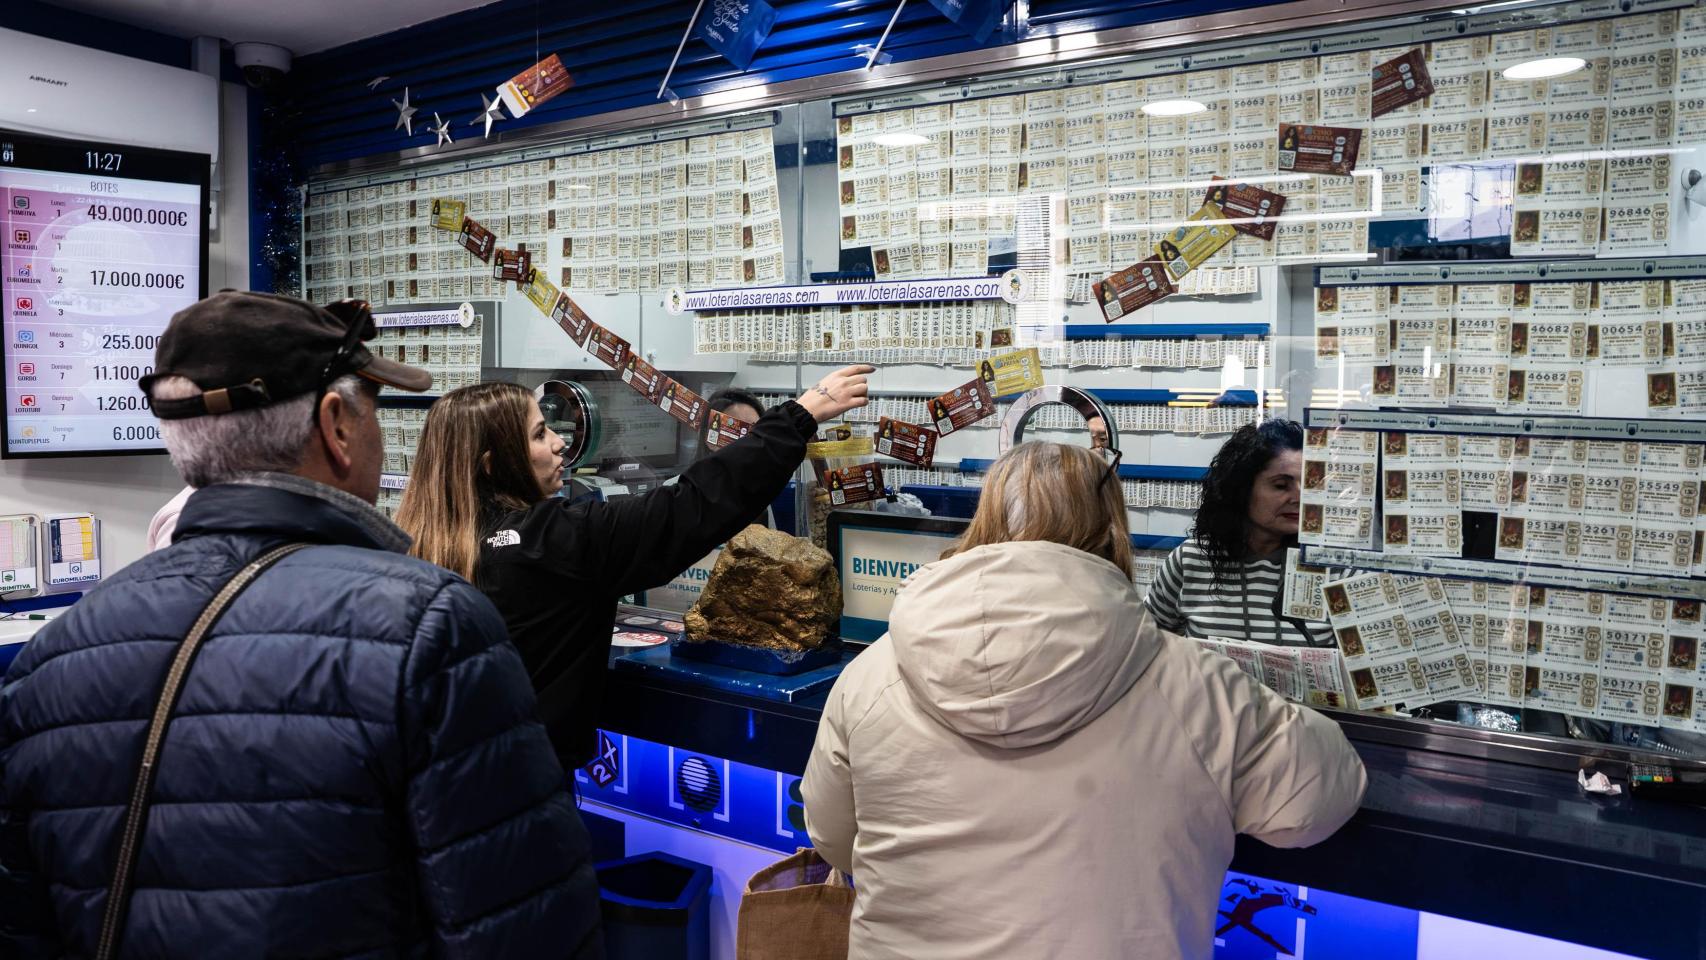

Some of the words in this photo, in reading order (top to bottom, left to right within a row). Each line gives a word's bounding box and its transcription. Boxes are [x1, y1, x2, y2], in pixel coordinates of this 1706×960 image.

[1613, 55, 1656, 67] 96846
[1433, 76, 1470, 86] 86475
[1324, 87, 1356, 97] 50773
[1234, 99, 1264, 108] 56663
[1108, 112, 1134, 120] 47972
[1550, 112, 1590, 121] 71646
[1612, 106, 1654, 118] 96846
[1029, 120, 1054, 130] 47761
[1066, 117, 1093, 128] 52182
[1492, 117, 1529, 127] 98705
[1372, 128, 1406, 137] 50993
[1431, 123, 1467, 133] 86475
[955, 129, 978, 137] 47541
[1189, 146, 1218, 154] 58443
[1234, 142, 1264, 150] 56663
[3, 151, 14, 162] 01
[1108, 153, 1135, 161] 47972
[86, 152, 122, 171] 11:27
[1030, 159, 1055, 168] 47761
[1069, 157, 1095, 167] 52182
[1611, 157, 1652, 168] 96846
[954, 167, 978, 175] 47541
[1547, 162, 1586, 171] 71646
[1322, 175, 1354, 185] 50773
[90, 181, 118, 193] BOTES
[1279, 182, 1303, 191] 6143
[1071, 197, 1096, 206] 52182
[88, 204, 187, 226] 49.000.000€
[1543, 211, 1582, 219] 71646
[1610, 207, 1650, 217] 96846
[1321, 222, 1353, 230] 50773
[1072, 237, 1098, 246] 52182
[58, 276, 63, 284] 2
[90, 270, 184, 289] 17.000.000€
[1400, 321, 1434, 329] 94633
[1459, 320, 1495, 328] 47481
[1341, 328, 1373, 336] 32571
[1531, 325, 1569, 333] 46682
[1602, 325, 1642, 335] 00654
[60, 372, 64, 380] 7
[1328, 464, 1360, 472] 95134
[1410, 472, 1444, 480] 32341
[1530, 474, 1568, 483] 95134
[1588, 478, 1619, 487] 2261
[1639, 481, 1680, 491] 55549
[1325, 507, 1358, 515] 95134
[1410, 517, 1444, 525] 32341
[1527, 521, 1564, 530] 95134
[1585, 525, 1616, 534] 2261
[487, 535, 508, 543] NORTH
[52, 575, 98, 584] EUROMILLONES
[852, 583, 881, 593] Loterías
[1347, 578, 1378, 591] 46633
[1360, 621, 1392, 632] 46633
[1546, 624, 1585, 635] 94154
[1607, 631, 1646, 642] 50171
[1373, 663, 1406, 675] 46633
[1543, 670, 1580, 682] 94154
[1603, 678, 1643, 689] 50171
